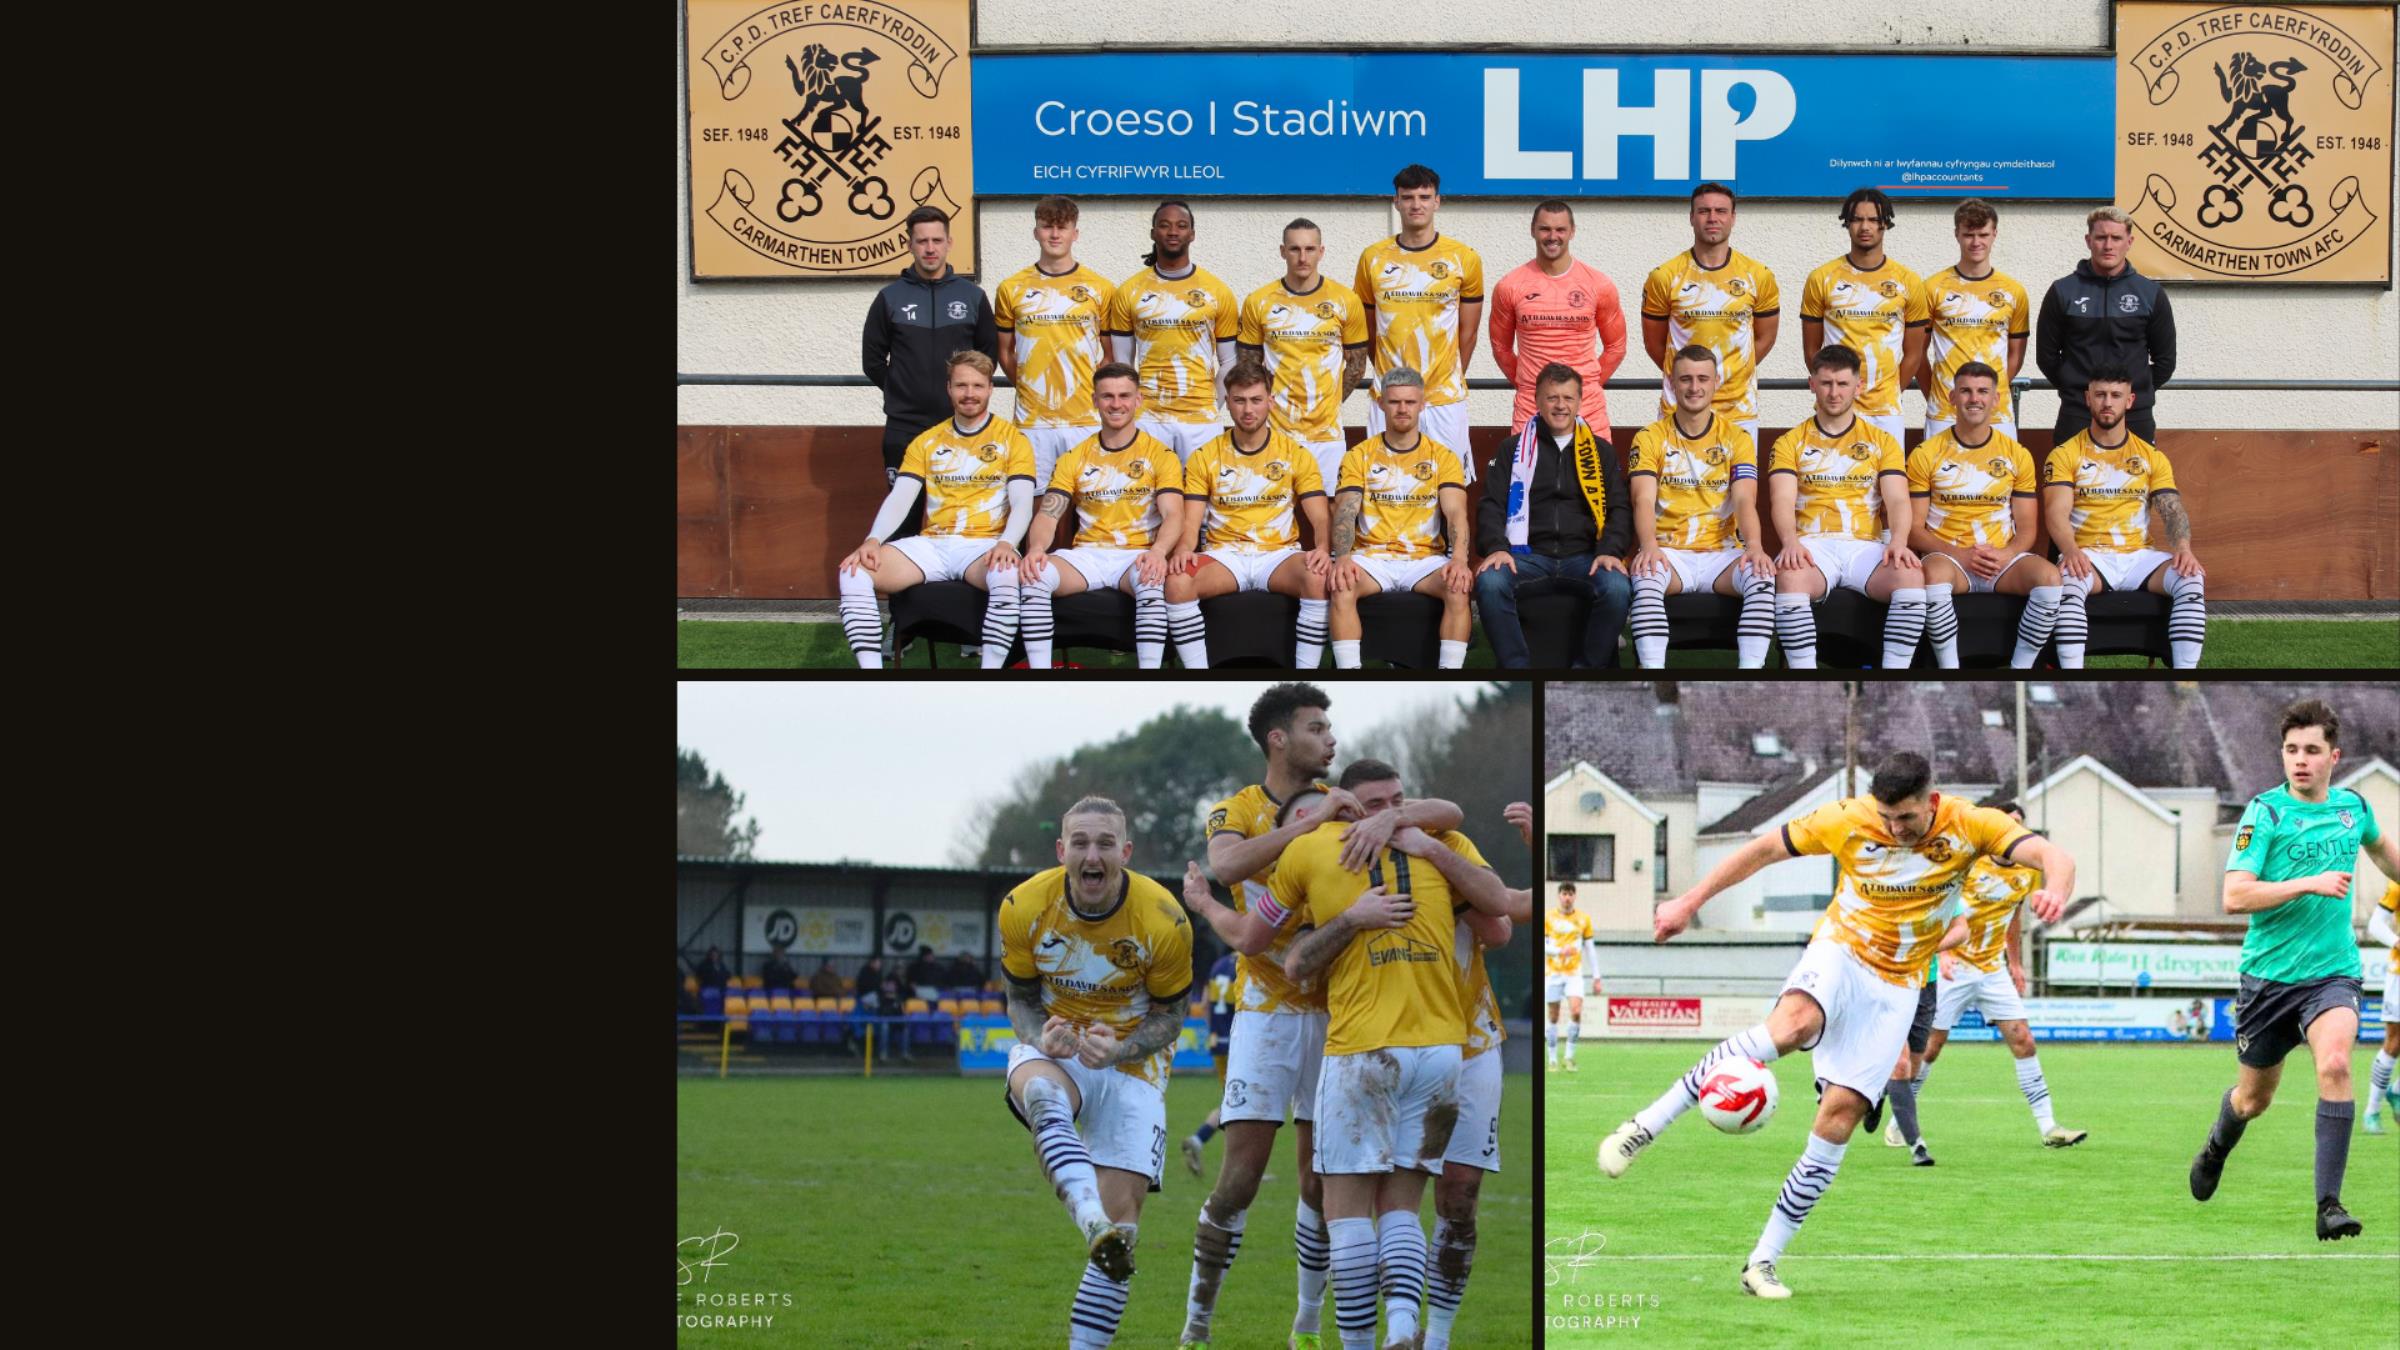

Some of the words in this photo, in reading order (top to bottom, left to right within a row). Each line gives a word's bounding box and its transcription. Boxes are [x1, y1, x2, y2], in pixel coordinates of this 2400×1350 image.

[720, 24, 768, 64] C.P.D.
[768, 5, 814, 31] TREF
[820, 3, 940, 64] CAERFYRDDIN
[2149, 31, 2196, 69] C.P.D.
[2198, 13, 2243, 36] TREF
[2250, 12, 2366, 76] CAERFYRDDIN
[1035, 100, 1194, 136] Croeso
[1232, 99, 1427, 136] Stadiwm
[1483, 68, 1797, 180] LHP
[702, 128, 733, 142] SEF.
[737, 128, 768, 141] 1948
[894, 126, 924, 140] EST.
[928, 126, 961, 140] 1948
[2128, 132, 2157, 146] SEF.
[2162, 132, 2194, 146] 1948
[2316, 136, 2346, 149] EST.
[2350, 136, 2381, 150] 1948
[1033, 165, 1071, 178] EICH
[1076, 165, 1170, 178] CYFRIFWYR
[1174, 165, 1224, 178] LLEOL
[1830, 159, 1872, 168] Dilynwch
[1945, 160, 1991, 170] cyfryngau
[1993, 160, 2056, 170] cymdeithasol
[1902, 172, 1984, 182] @lhpaccountants
[733, 216, 842, 264] CARMARTHEN
[846, 240, 897, 264] TOWN
[2152, 221, 2260, 270] CARMARTHEN
[2264, 250, 2312, 270] TOWN
[2316, 228, 2344, 256] AFC
[906, 310, 916, 320] 14
[1578, 438, 1597, 480] TOWN
[2287, 838, 2359, 862] GENTLE
[768, 918, 793, 941] JD
[890, 921, 914, 944] JD
[1610, 1006, 1700, 1020] VAUGHAN
